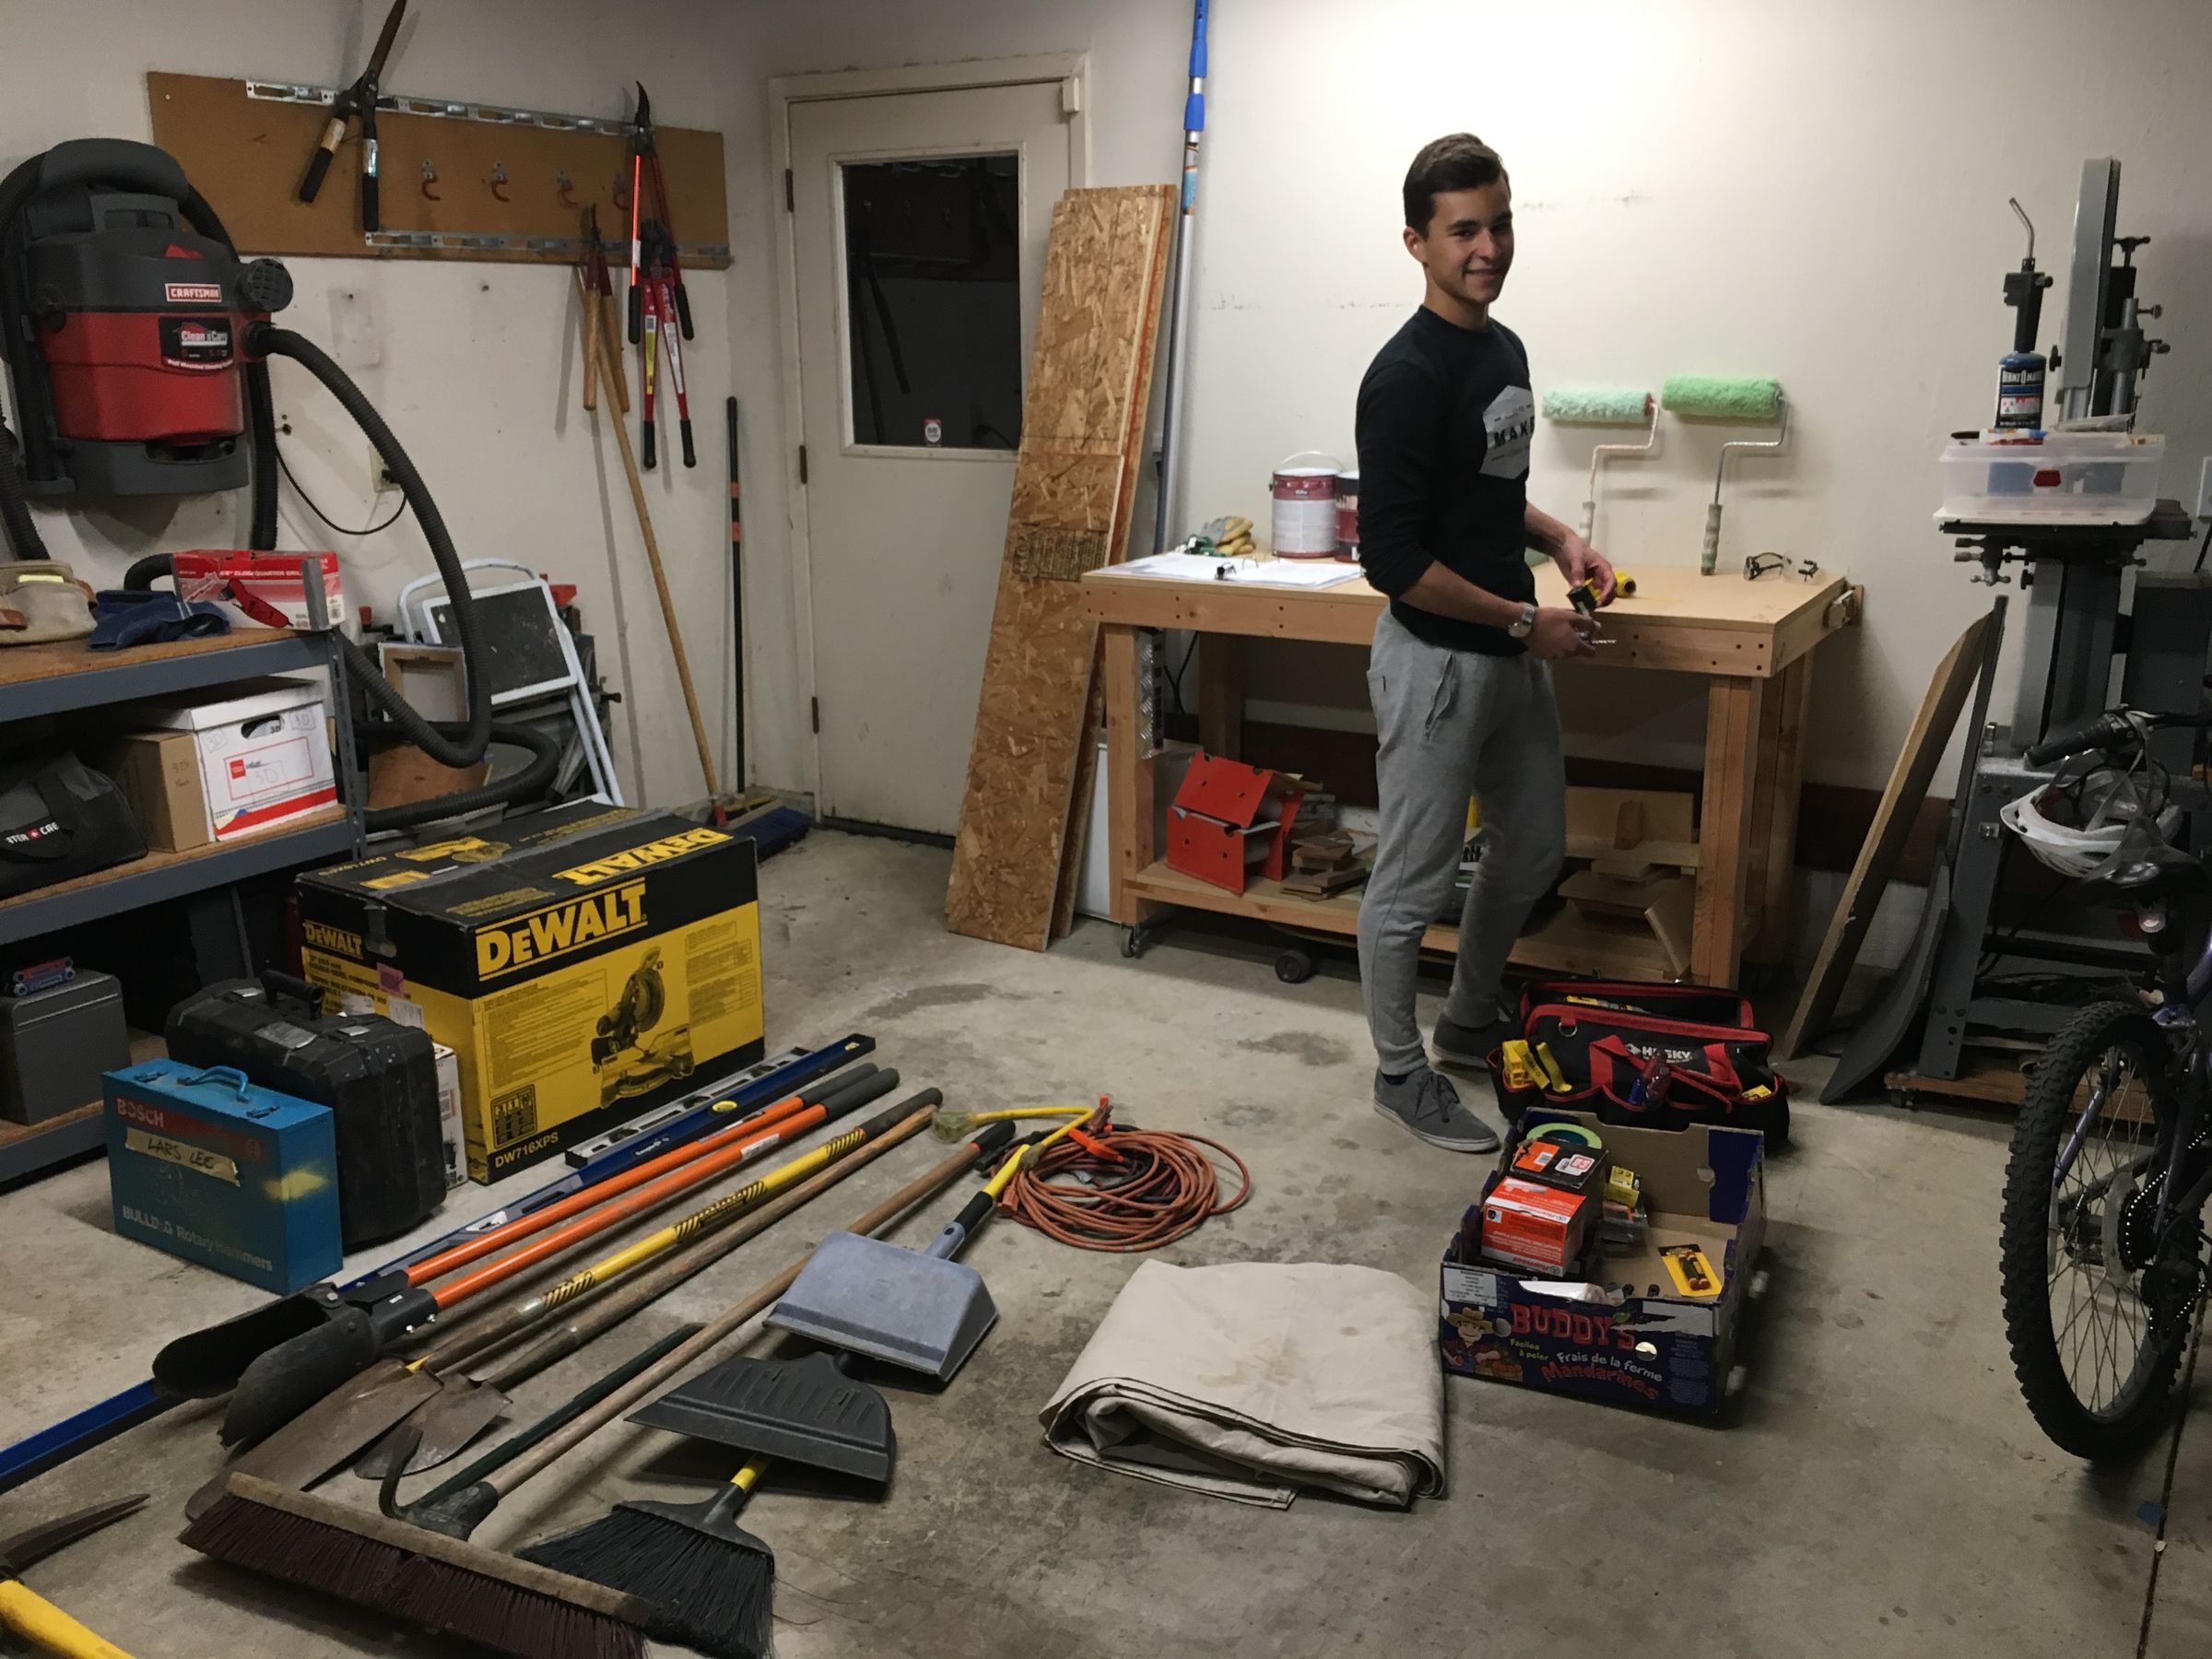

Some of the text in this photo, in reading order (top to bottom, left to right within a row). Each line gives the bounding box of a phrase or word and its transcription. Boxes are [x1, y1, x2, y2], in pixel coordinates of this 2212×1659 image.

[171, 288, 218, 299] CRAFTSMAN
[305, 923, 362, 956] DEWALT
[478, 883, 645, 975] DEWALT
[147, 1136, 214, 1170] LARS LEE
[495, 1131, 559, 1168] DW716XPS
[123, 1205, 172, 1235] BULLDG
[177, 1225, 216, 1251] Rotary
[1510, 1304, 1635, 1350] BUDDY'S
[1540, 1361, 1658, 1401] Mandarines
[1557, 1351, 1664, 1382] Frais de la ferme
